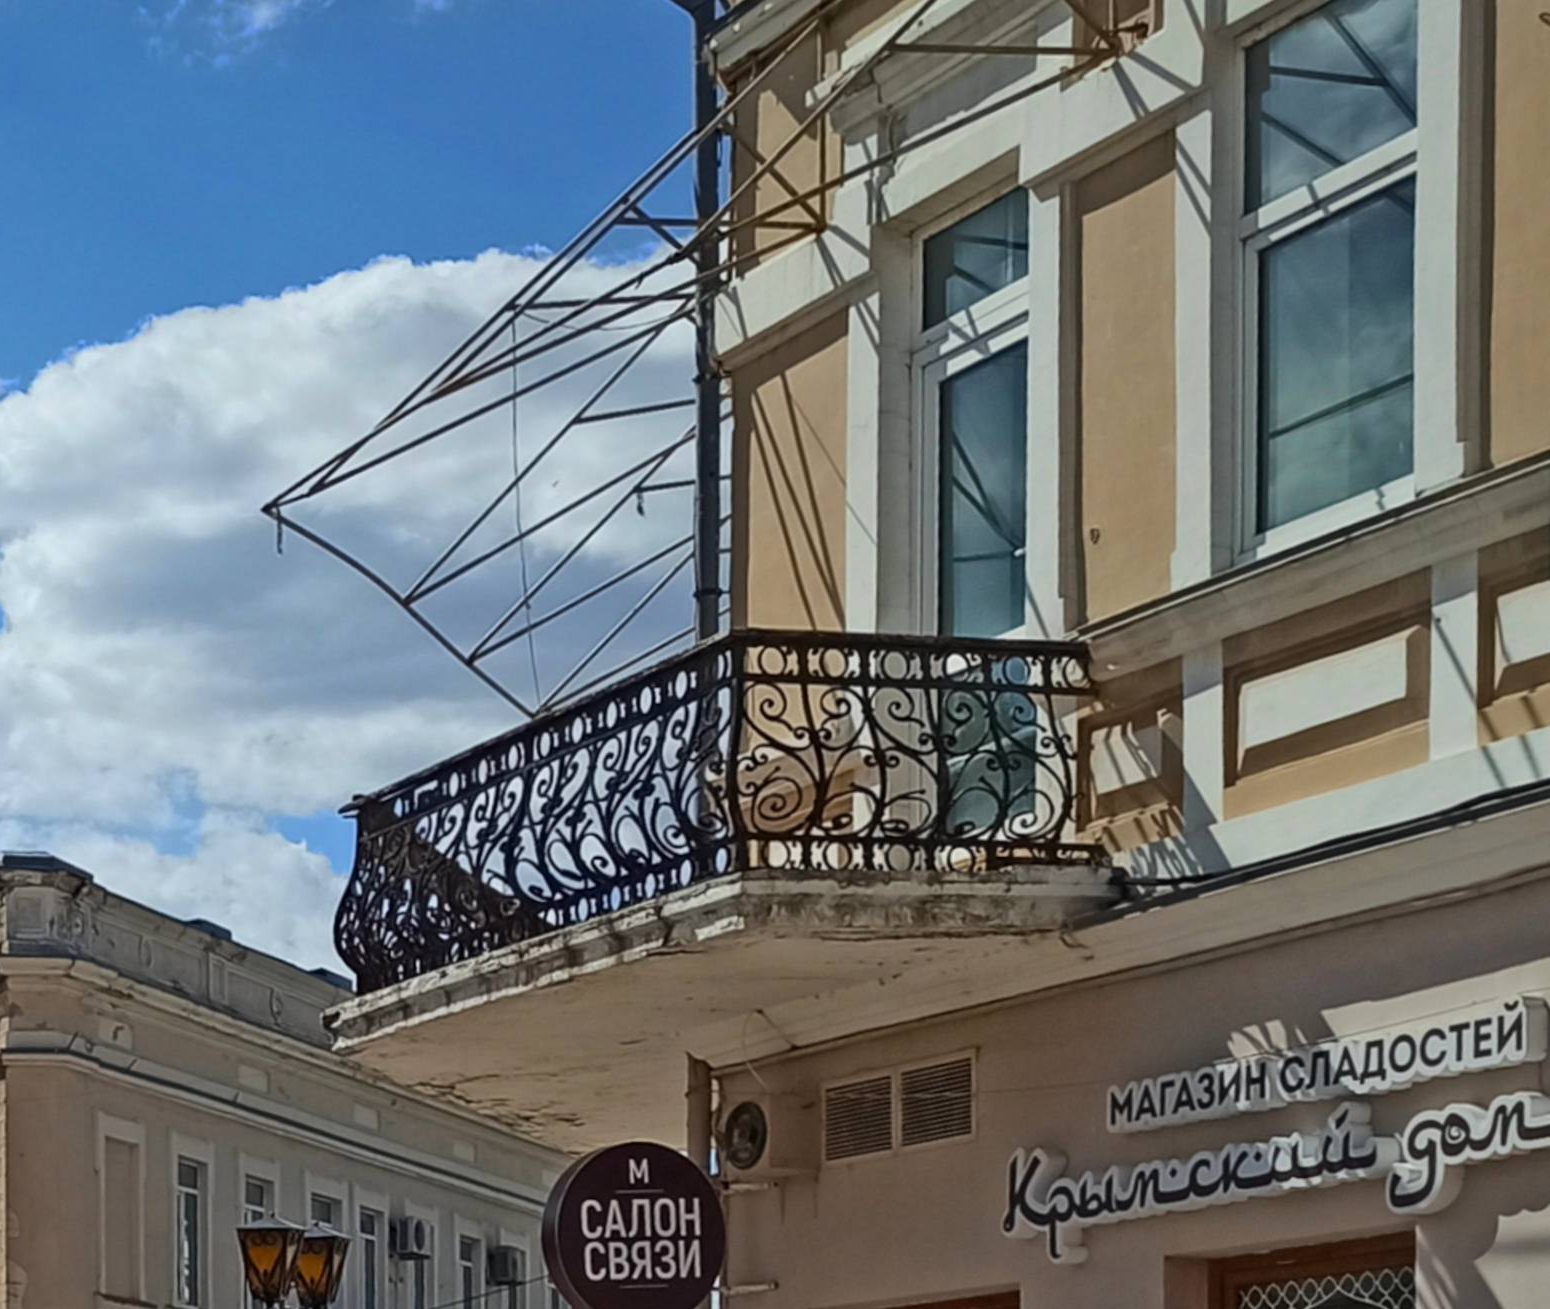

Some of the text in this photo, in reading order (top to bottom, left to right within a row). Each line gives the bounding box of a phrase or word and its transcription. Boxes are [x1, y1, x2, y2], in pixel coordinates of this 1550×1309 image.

[1108, 1000, 1525, 1128] МАГАЗИН СЛАДОСТЕЙ
[627, 1157, 650, 1185] М
[1002, 1108, 1377, 1259] Крымский
[580, 1197, 701, 1239] САЛОН
[584, 1239, 701, 1281] СВЯЗИ
